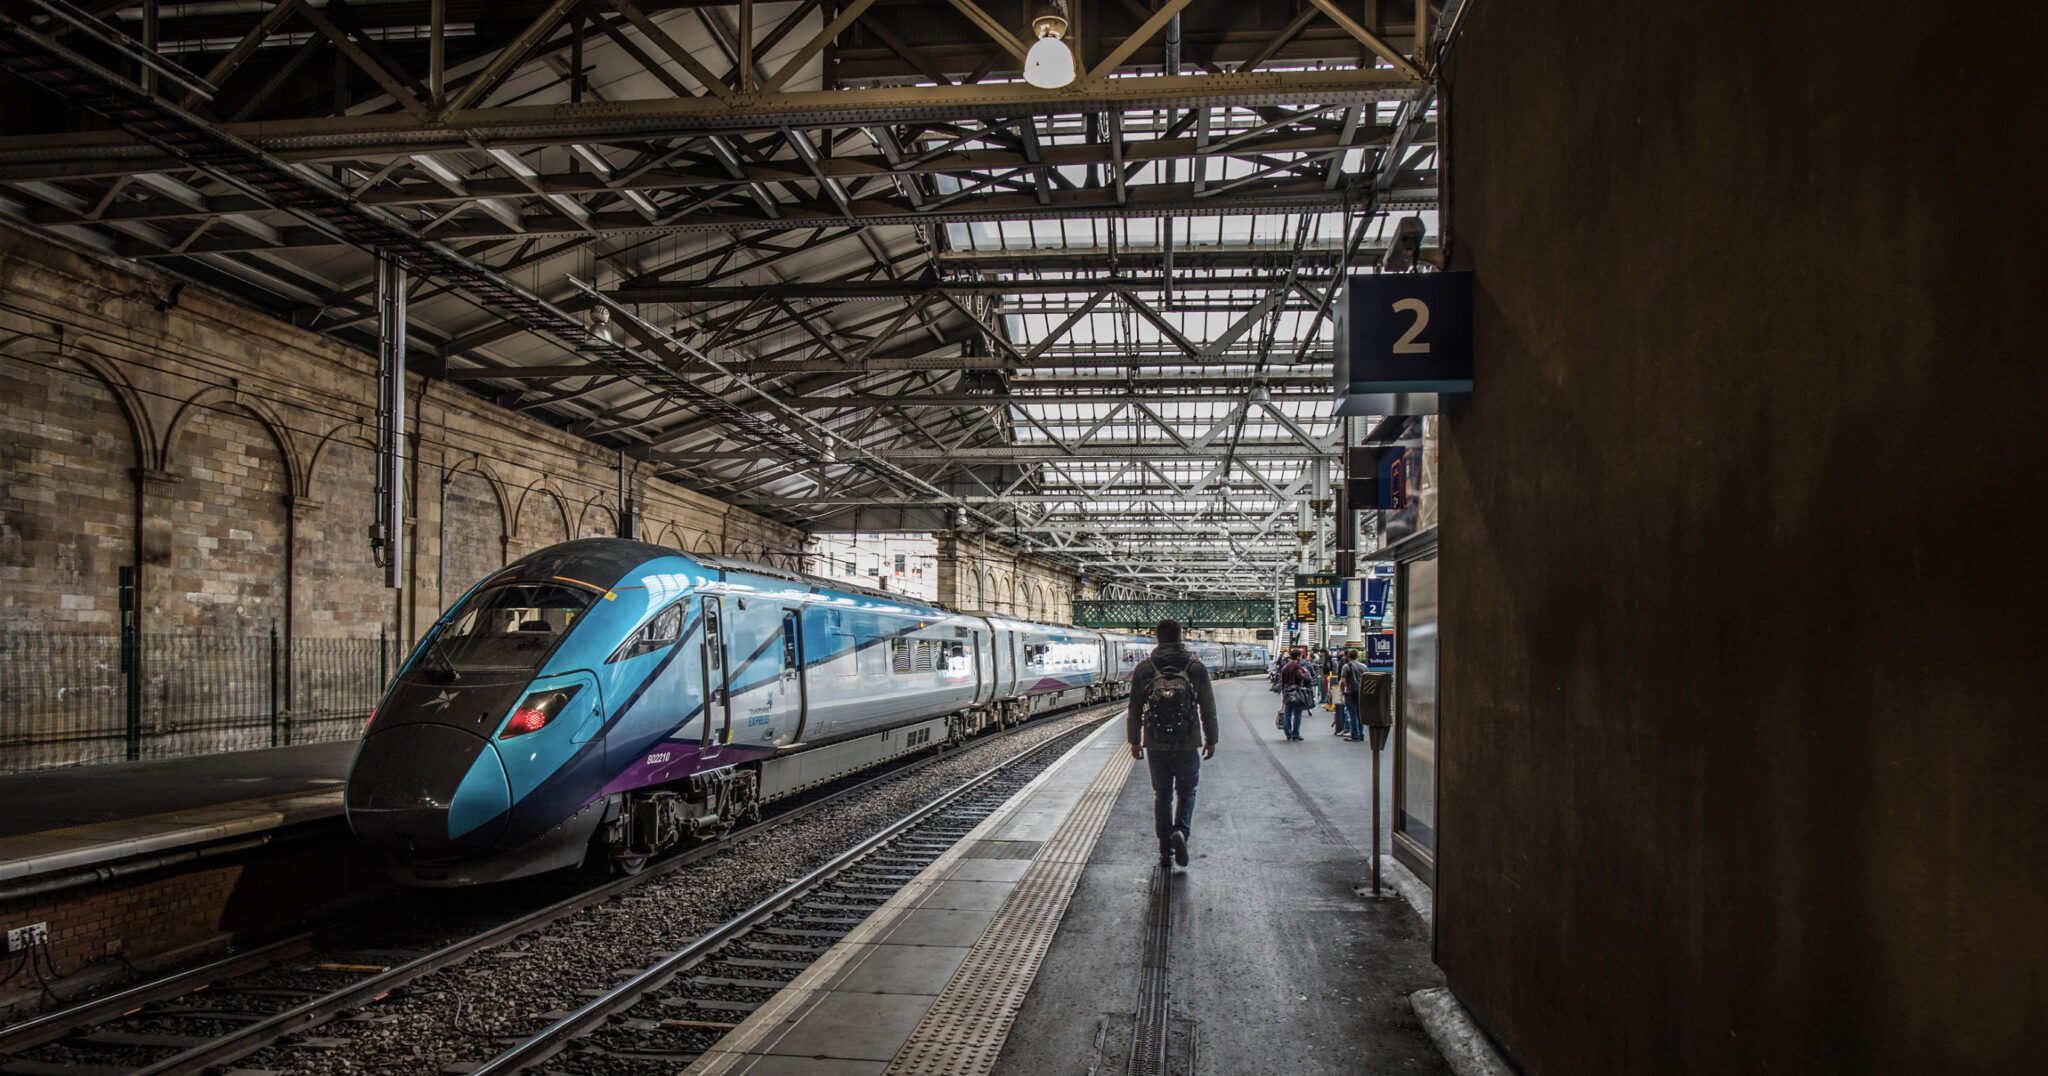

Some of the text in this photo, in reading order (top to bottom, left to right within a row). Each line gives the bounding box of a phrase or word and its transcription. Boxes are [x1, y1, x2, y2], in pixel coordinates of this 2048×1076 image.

[1392, 298, 1430, 354] 2
[1369, 604, 1377, 614] 2
[647, 752, 671, 765] 802210
